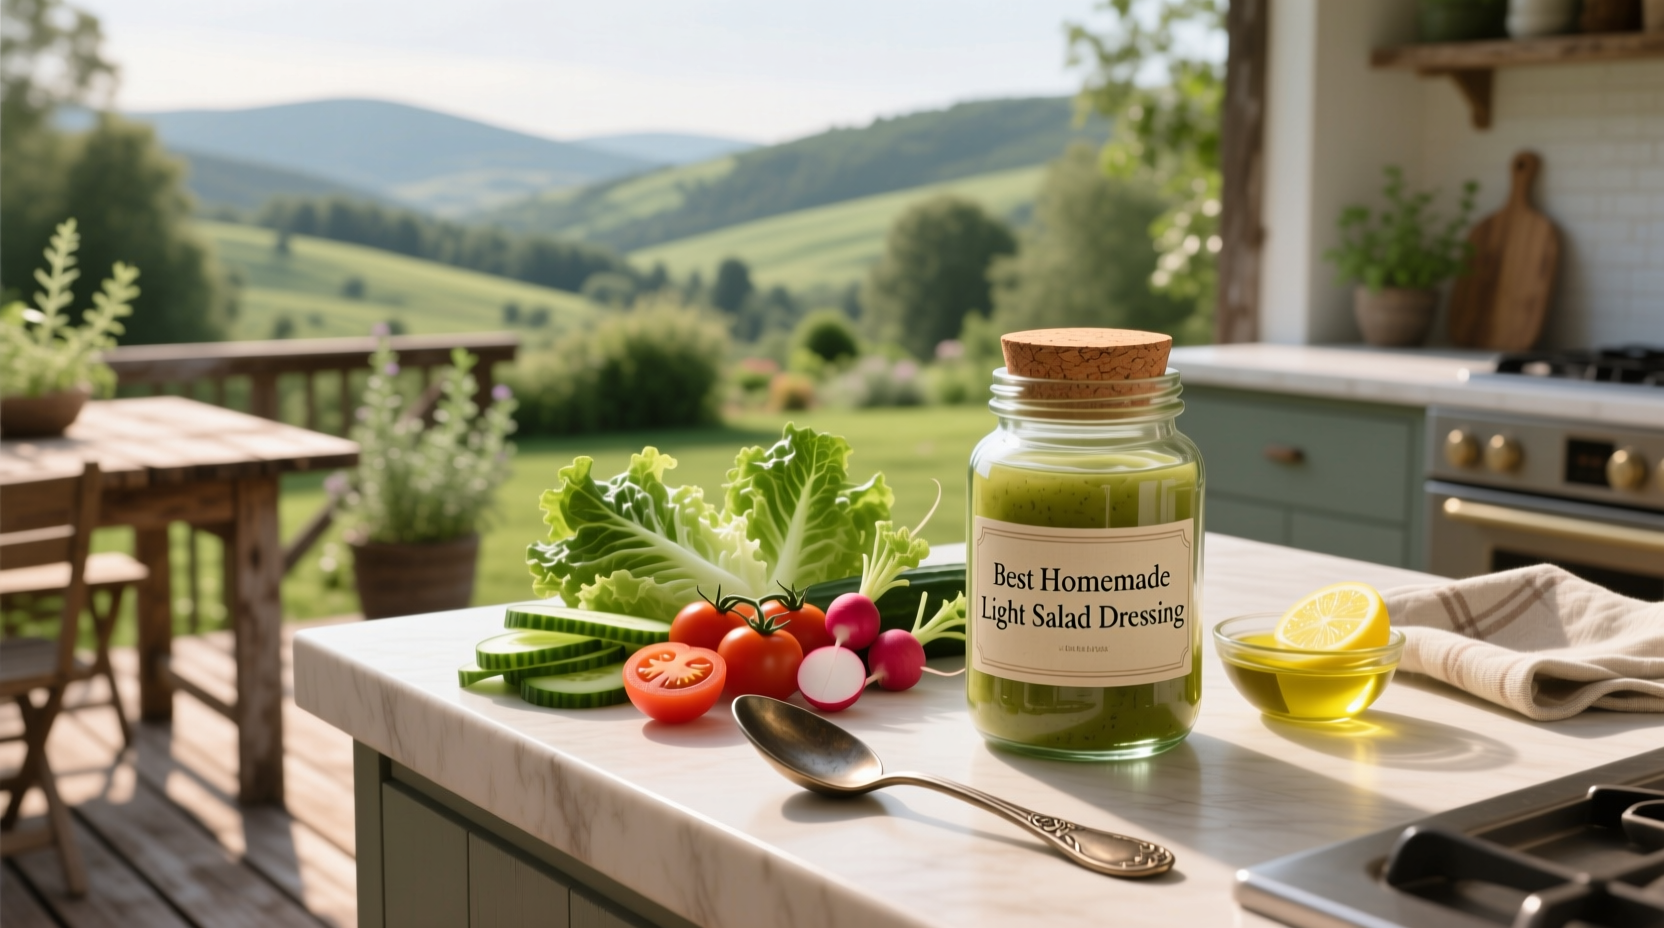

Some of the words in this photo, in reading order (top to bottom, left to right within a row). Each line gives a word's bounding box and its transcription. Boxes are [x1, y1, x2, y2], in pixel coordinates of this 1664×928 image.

[993, 562, 1034, 590] Best
[1040, 564, 1170, 592] Homemade
[981, 595, 1025, 630] Light
[1032, 603, 1091, 629] Salad
[1099, 601, 1185, 629] Dressing
